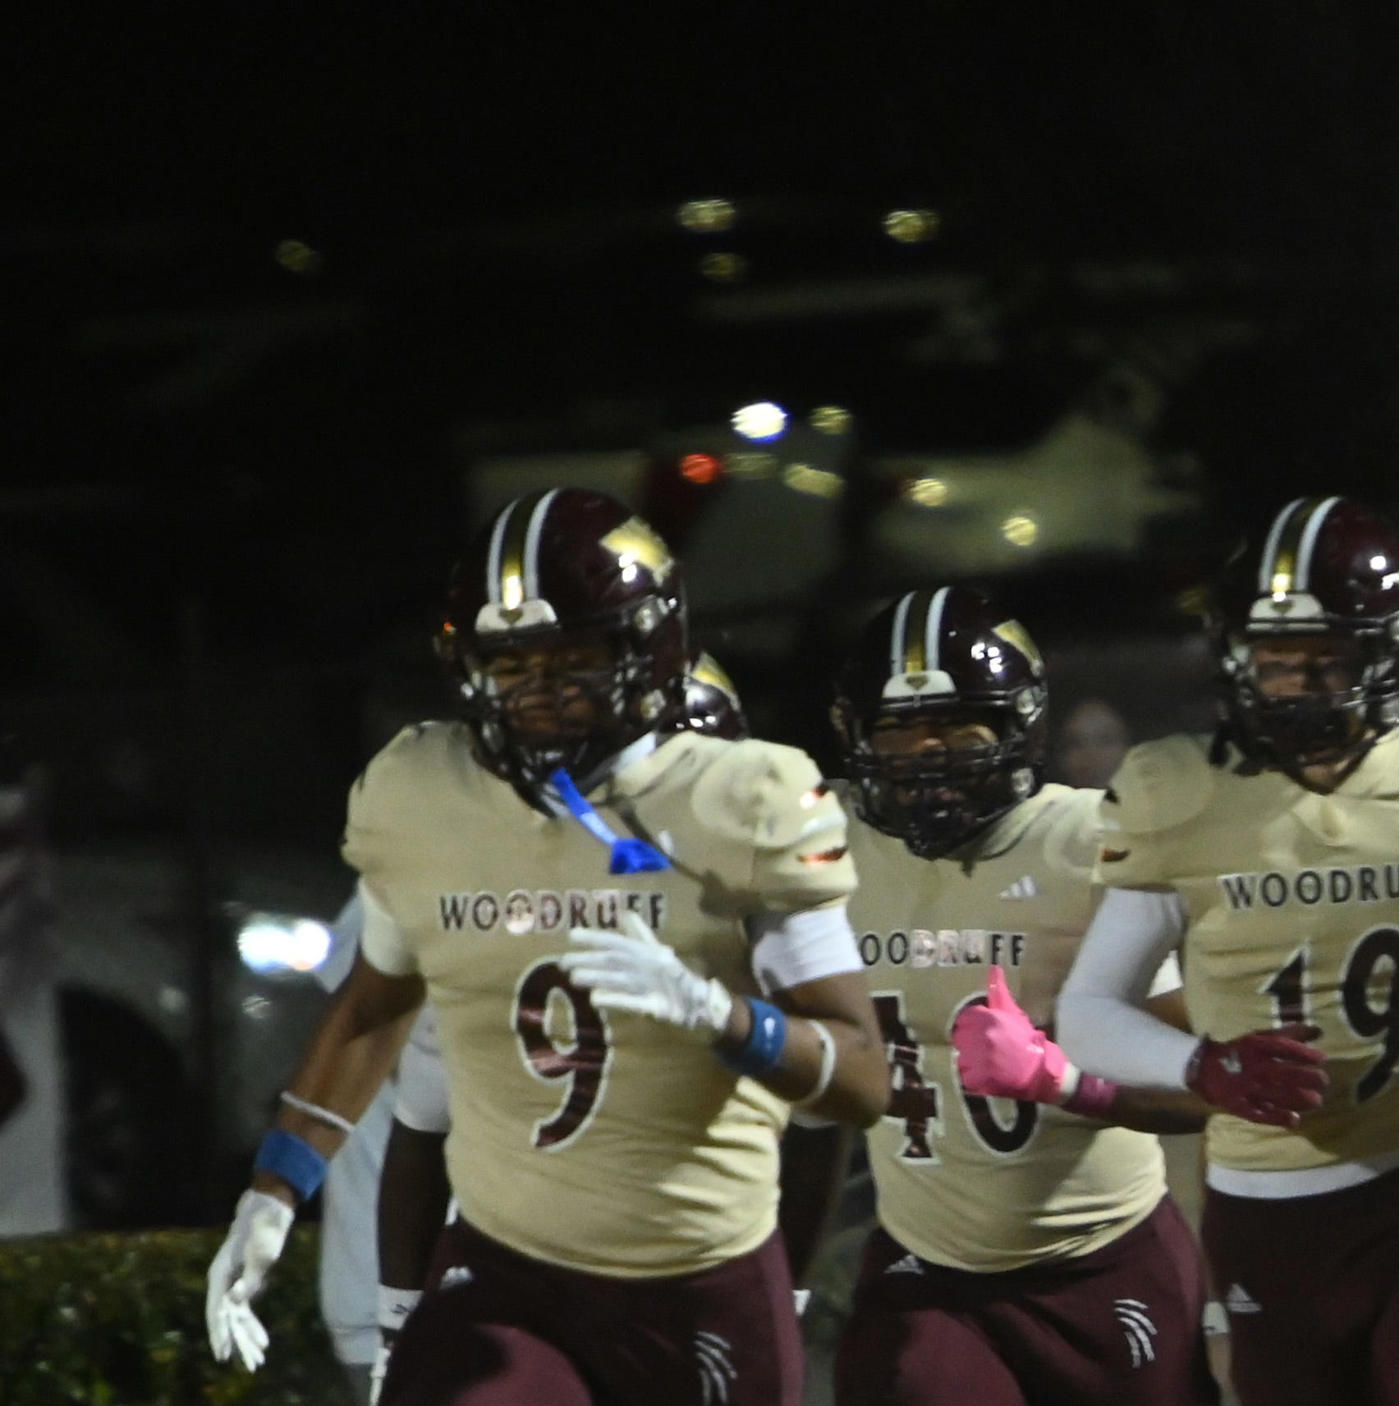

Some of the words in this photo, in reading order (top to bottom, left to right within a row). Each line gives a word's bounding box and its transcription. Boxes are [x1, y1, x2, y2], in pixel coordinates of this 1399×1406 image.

[439, 889, 664, 932] WOODRUFF
[858, 929, 1026, 967] OODRUFF
[511, 954, 613, 1151] 9
